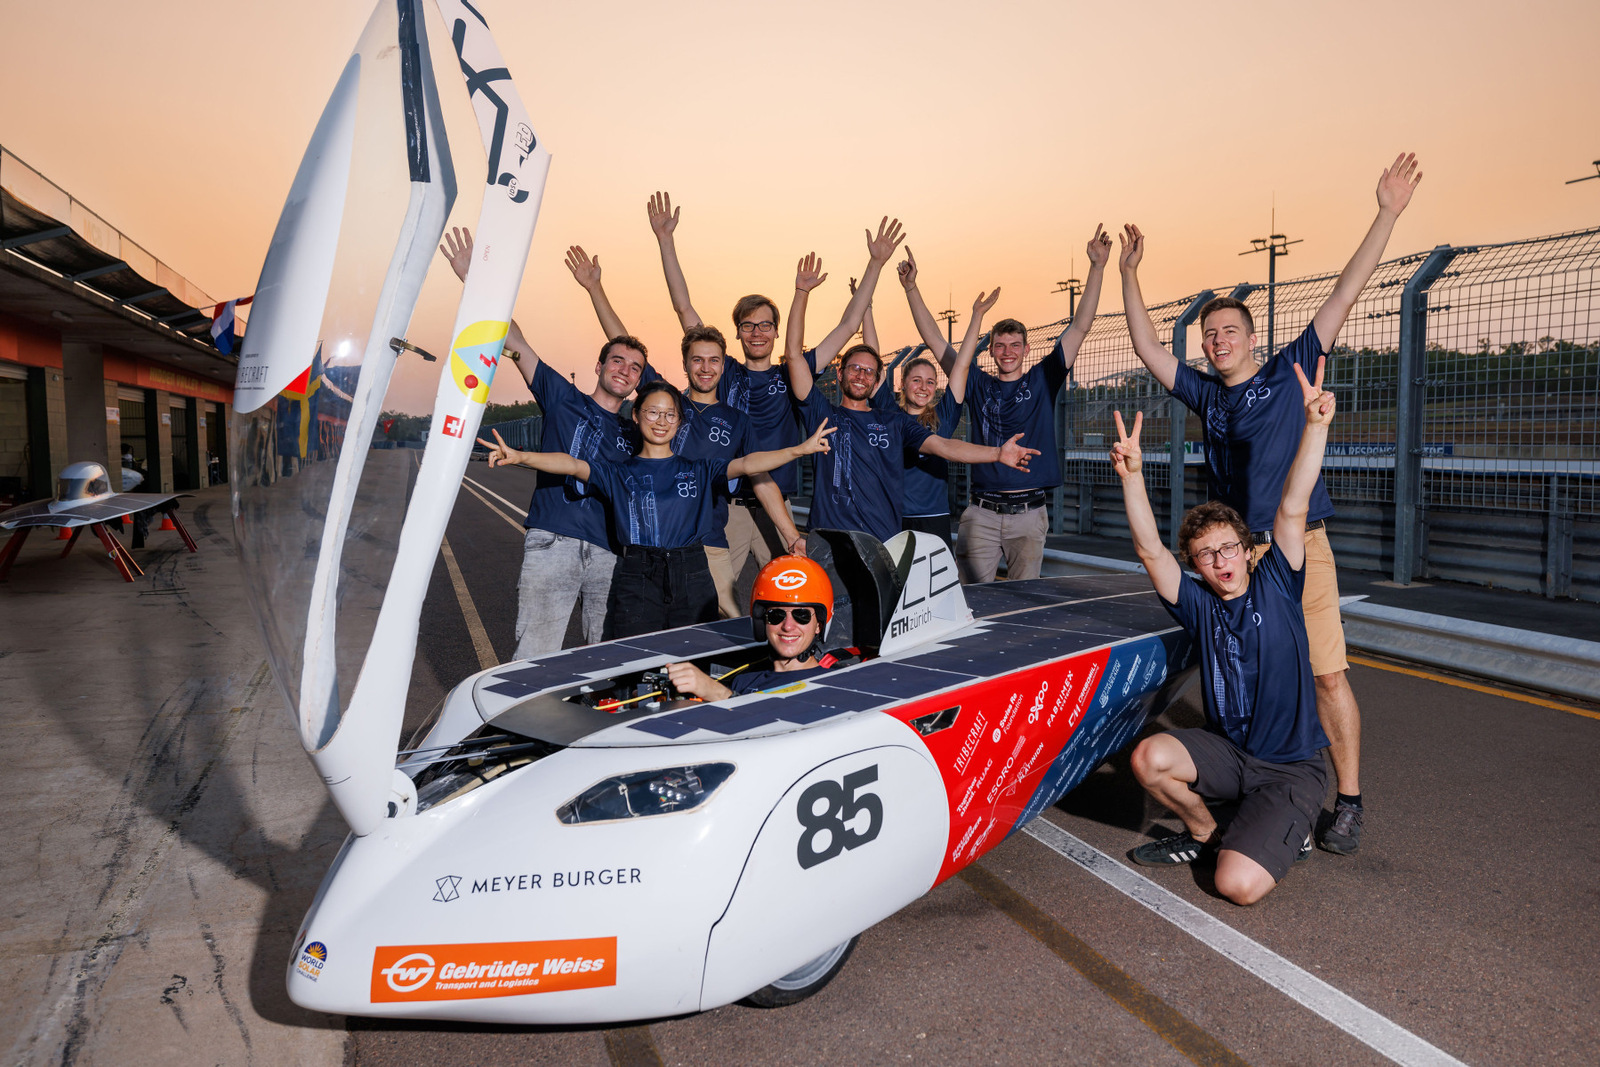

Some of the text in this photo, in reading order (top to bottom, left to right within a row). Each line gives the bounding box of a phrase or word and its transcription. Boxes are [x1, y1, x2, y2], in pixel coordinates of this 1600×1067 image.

[708, 426, 731, 447] 85
[677, 480, 697, 498] 85
[1000, 693, 1018, 728] Swiss Re
[1003, 694, 1024, 734] Foundation
[1047, 670, 1073, 728] FABRIMEX
[953, 710, 985, 773] TRIBECRAFT
[976, 758, 993, 789] RUAG
[987, 757, 1014, 804] ESORO
[957, 776, 977, 812] Together
[797, 764, 883, 870] 85
[471, 868, 642, 894] MEYER BURGER
[298, 961, 321, 976] SOLAR
[301, 954, 324, 970] WORLD
[438, 956, 605, 980] Gebrüder Weiss
[435, 978, 540, 991] Transport and Logistics
